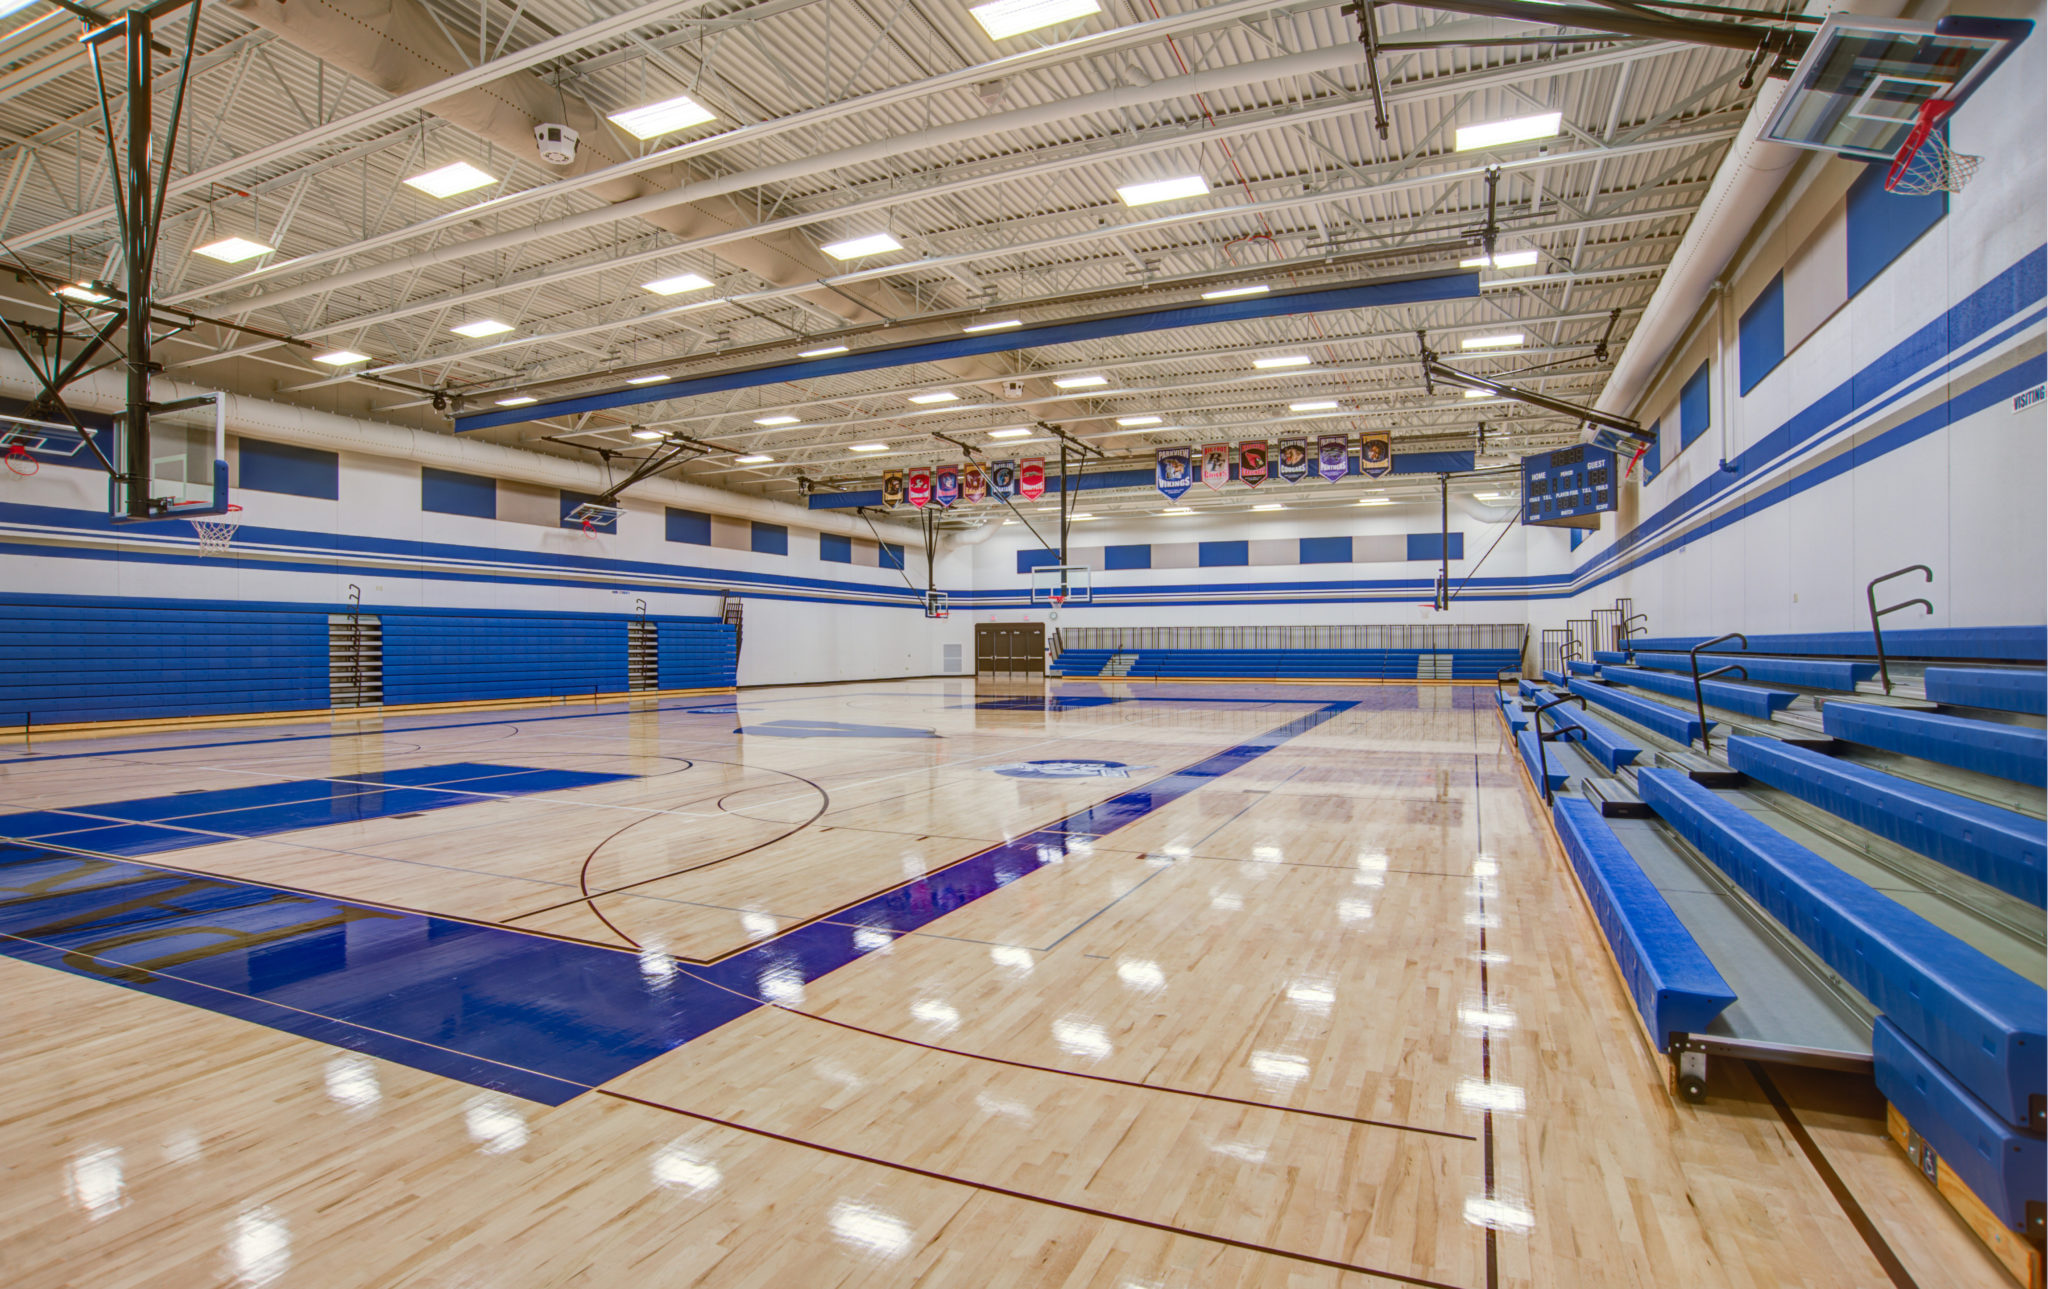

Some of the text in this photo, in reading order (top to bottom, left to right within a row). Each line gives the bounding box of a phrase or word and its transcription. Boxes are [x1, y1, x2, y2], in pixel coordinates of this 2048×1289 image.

[2013, 385, 2046, 411] VISITING
[1280, 438, 1306, 449] CLINTON
[1158, 449, 1190, 460] PARKVIEW
[1280, 463, 1306, 473] COUGARS
[1587, 459, 1605, 470] GUEST
[1531, 472, 1546, 481] HOME
[1158, 477, 1190, 488] VIKINGS
